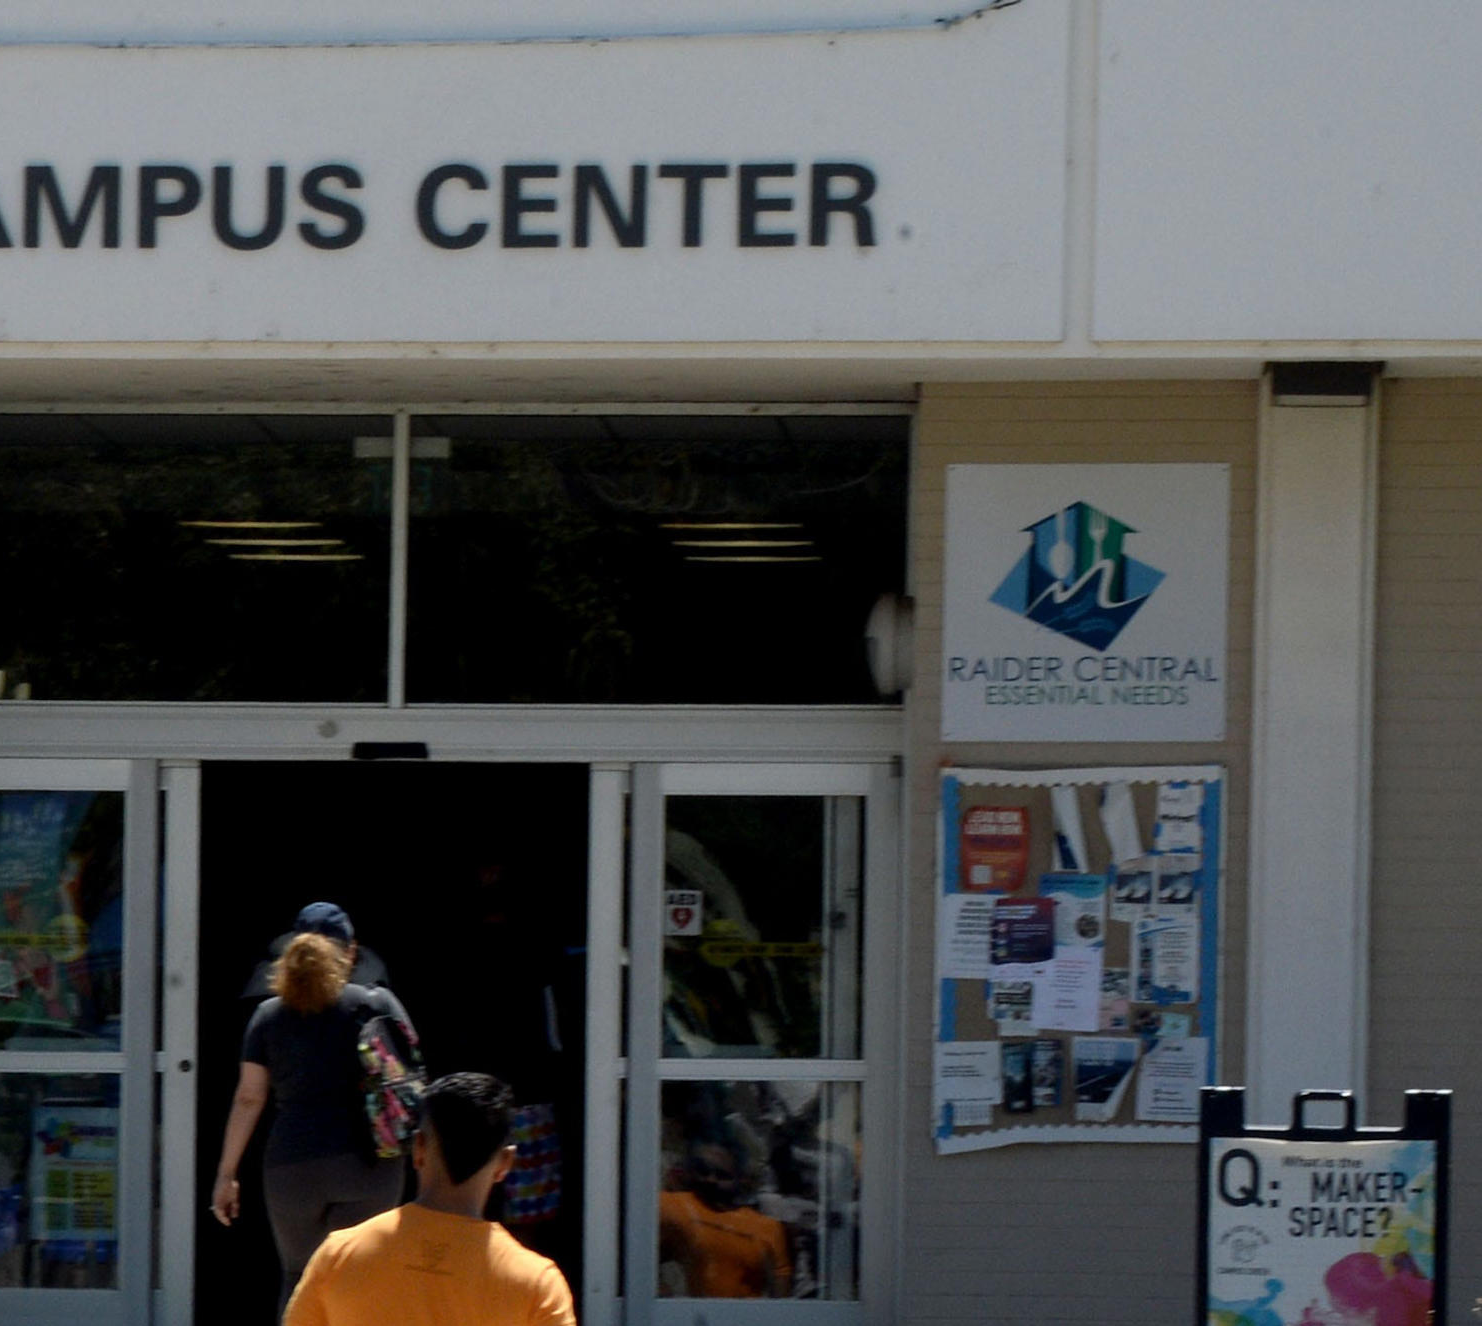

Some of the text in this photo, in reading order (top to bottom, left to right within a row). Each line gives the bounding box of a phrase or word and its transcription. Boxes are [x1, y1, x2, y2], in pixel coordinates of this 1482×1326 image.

[414, 163, 880, 251] CENTER
[947, 656, 1219, 682] RAIDER CENTRAL
[986, 685, 1189, 706] ESSENTIAL NEEDS
[1218, 1148, 1281, 1207] Q:
[1288, 1206, 1393, 1237] SPACE?
